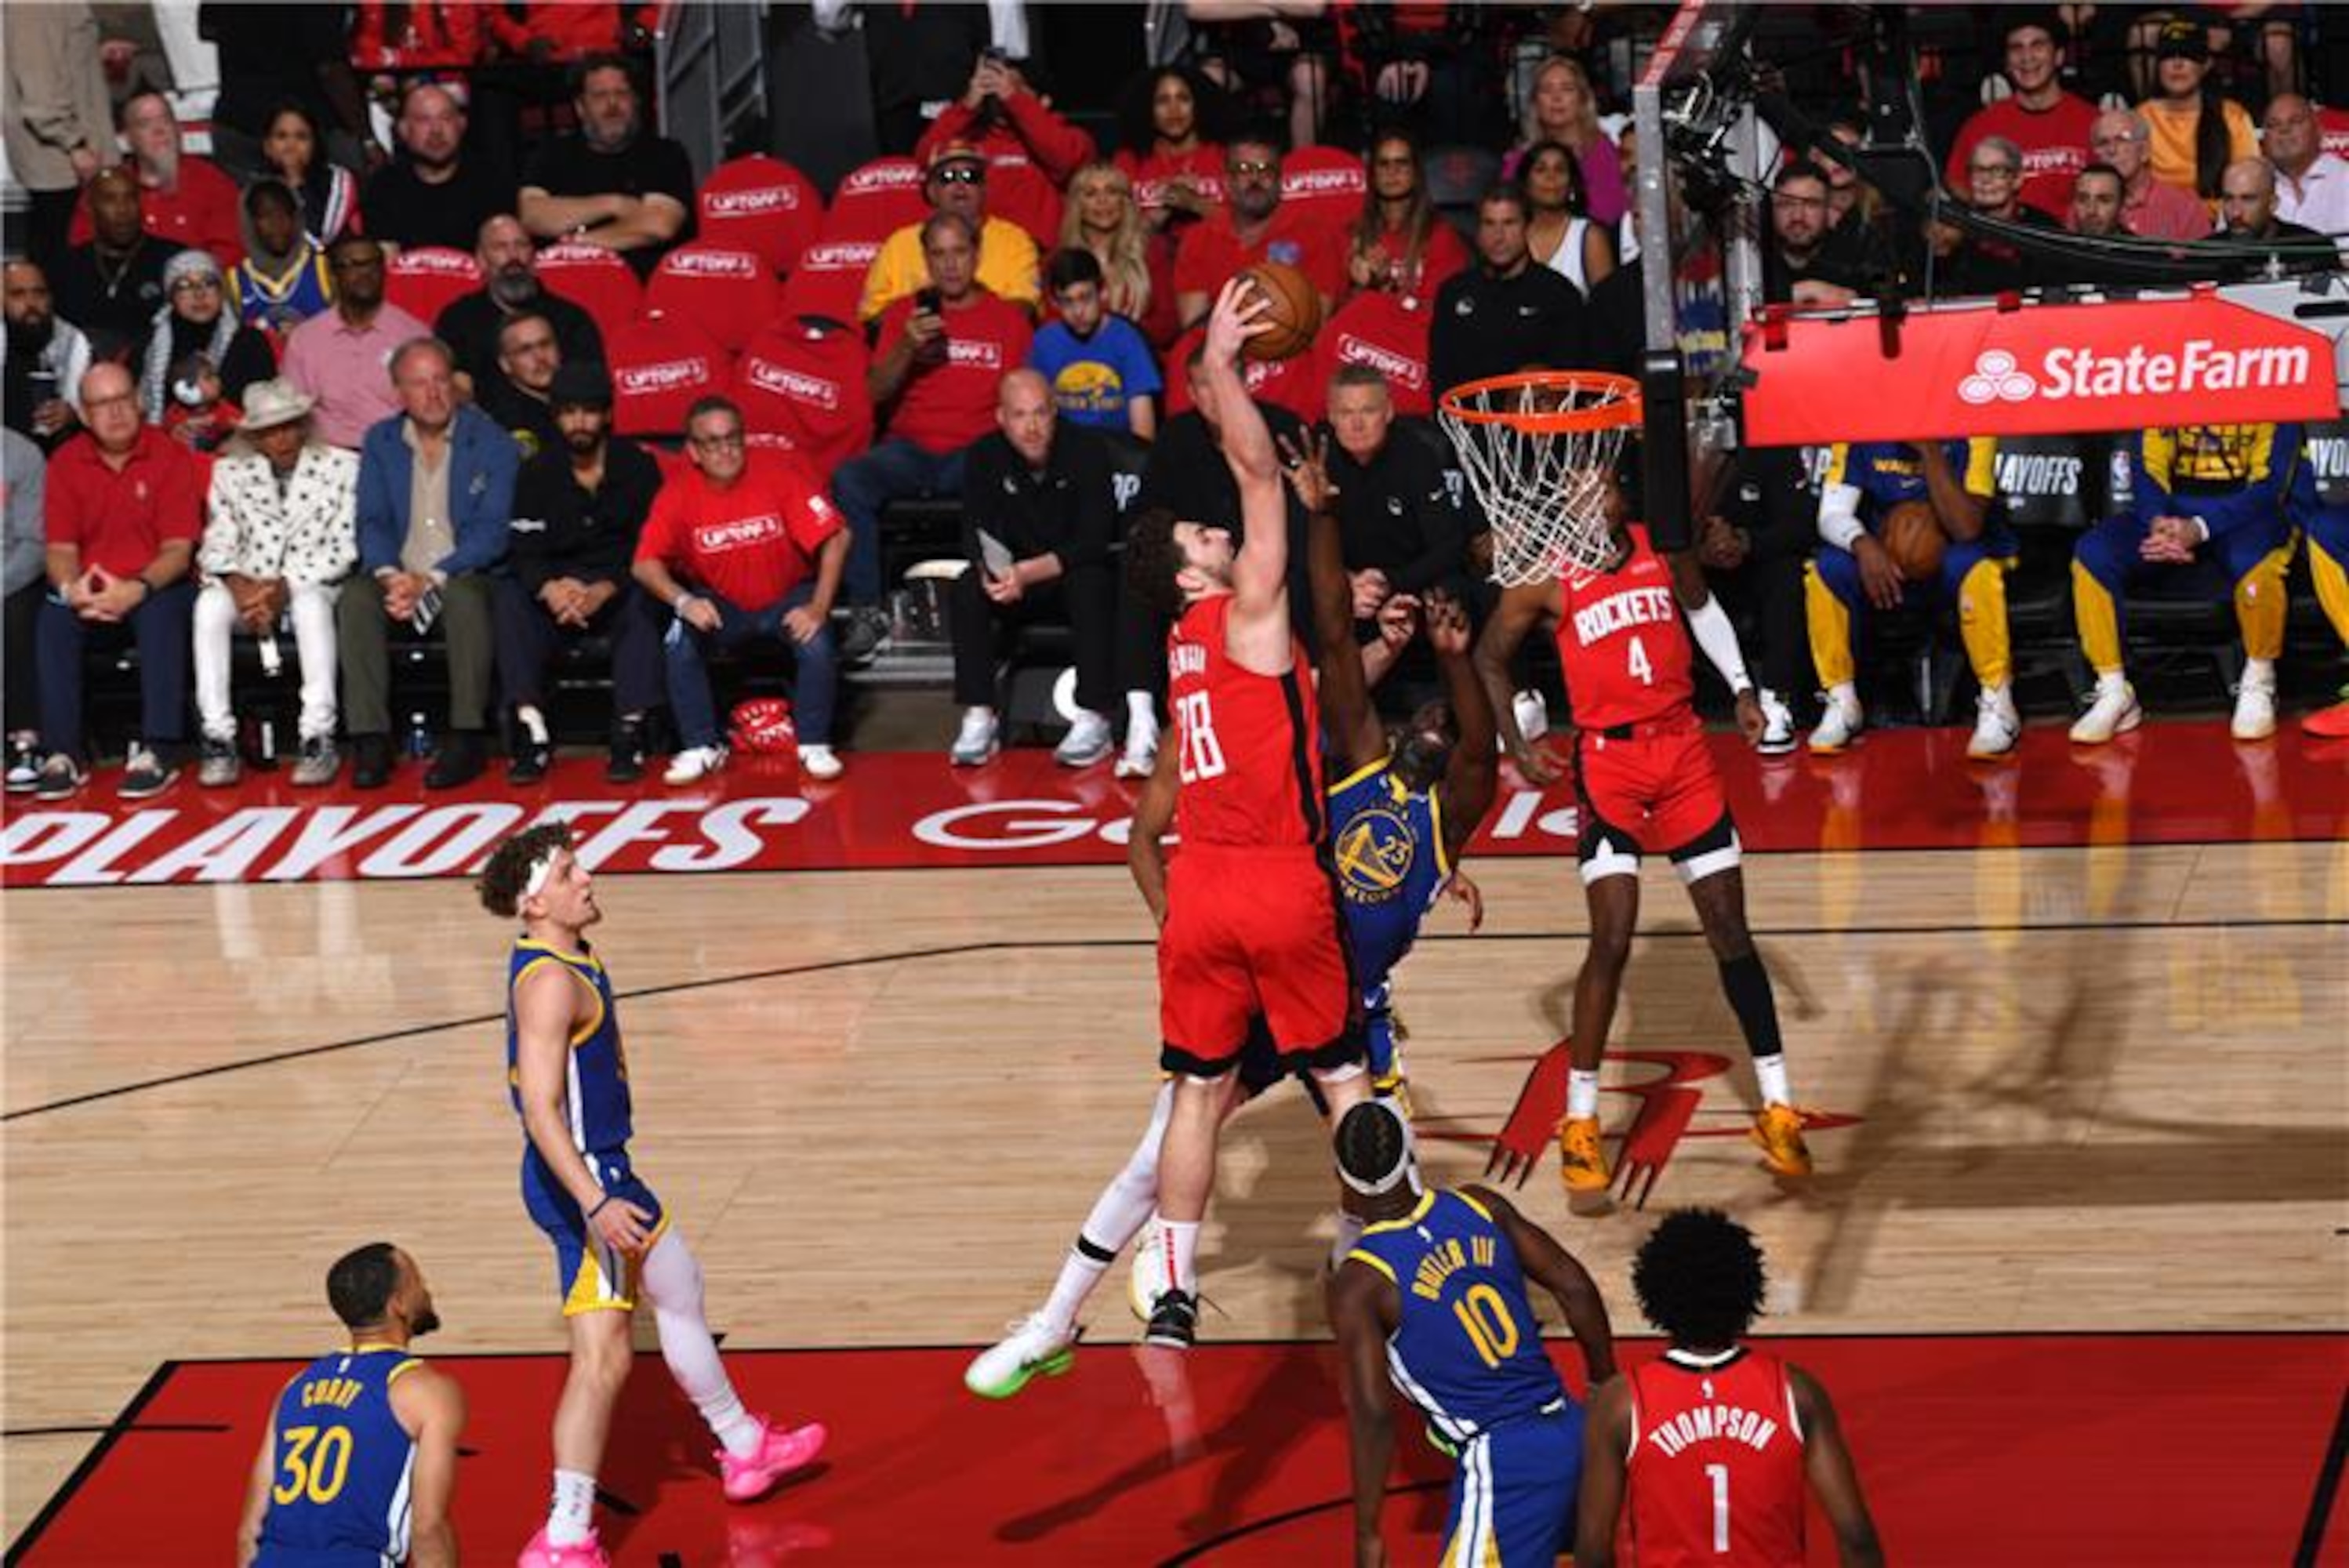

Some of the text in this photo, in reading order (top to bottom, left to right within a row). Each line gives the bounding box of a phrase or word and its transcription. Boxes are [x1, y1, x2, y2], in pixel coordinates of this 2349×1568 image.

[2041, 339, 2310, 399] State Farm
[1574, 586, 1673, 647] ROCKETS
[1628, 635, 1652, 686] 4
[1176, 688, 1226, 785] 28
[1378, 835, 1411, 866] 23
[1411, 1237, 1467, 1301] BUTLER
[1452, 1283, 1520, 1369] 10
[302, 1377, 364, 1410] CURRY
[1648, 1404, 1778, 1458] THOMPSON
[274, 1425, 354, 1504] 30
[1705, 1463, 1730, 1553] 1
